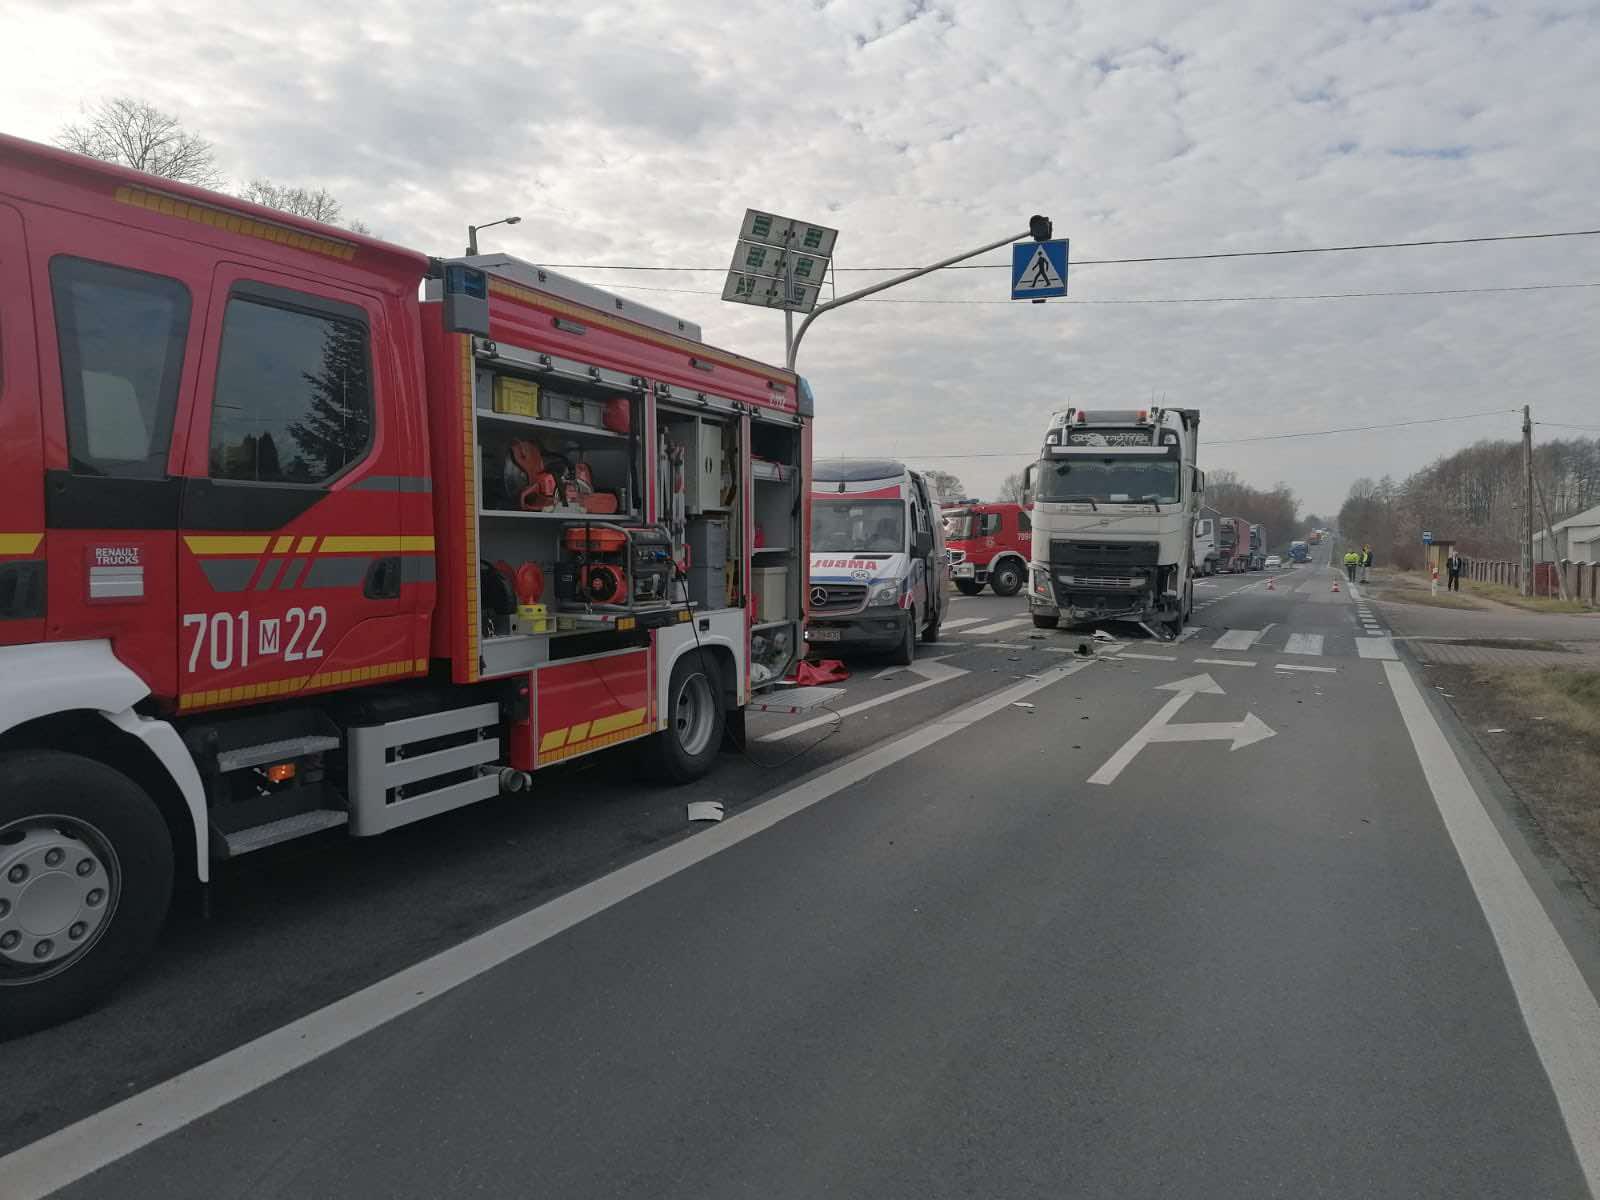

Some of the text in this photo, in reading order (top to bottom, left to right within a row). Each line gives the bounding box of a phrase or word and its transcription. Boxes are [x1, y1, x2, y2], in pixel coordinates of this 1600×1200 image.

[95, 547, 139, 556] RENAULT
[95, 556, 140, 565] TRUCKS
[183, 605, 328, 673] 701 M 22
